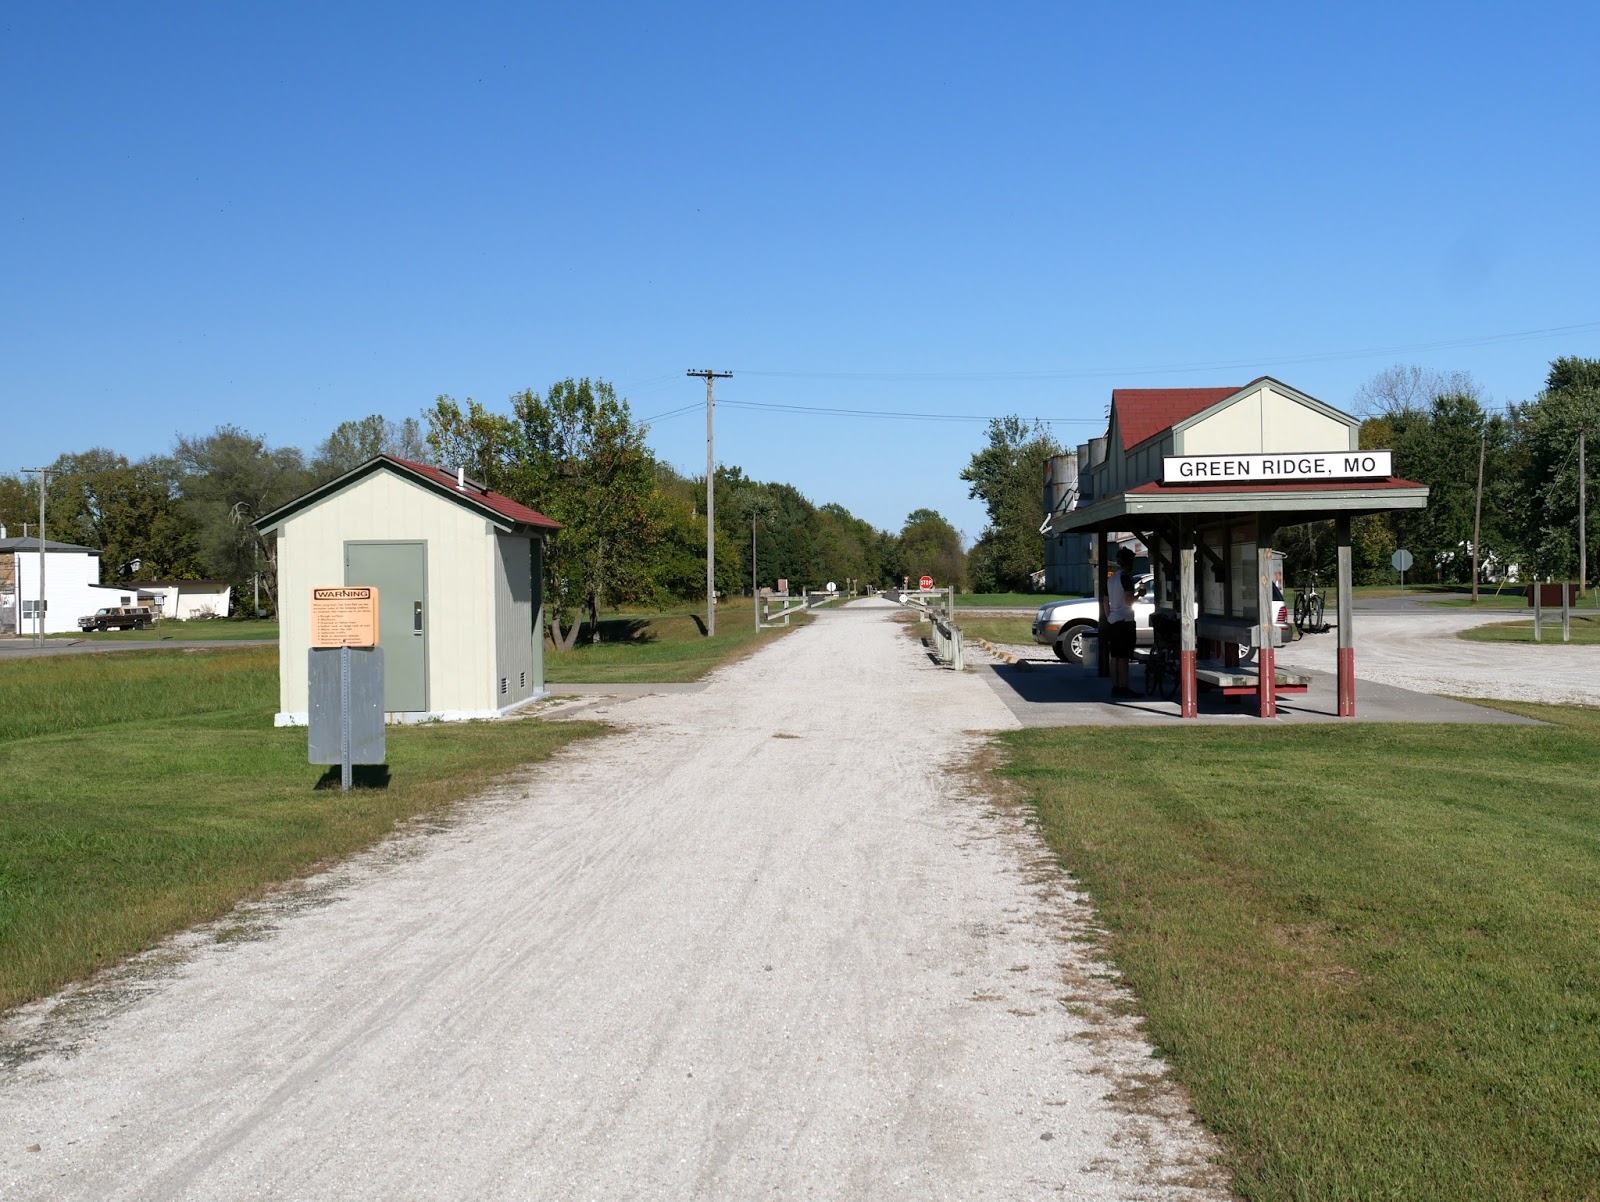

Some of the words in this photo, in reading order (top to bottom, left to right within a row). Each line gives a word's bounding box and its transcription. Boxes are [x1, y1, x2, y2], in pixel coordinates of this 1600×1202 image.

[1179, 460, 1250, 476] GREEN
[1262, 458, 1332, 475] RIDGE,
[1344, 457, 1376, 472] MO
